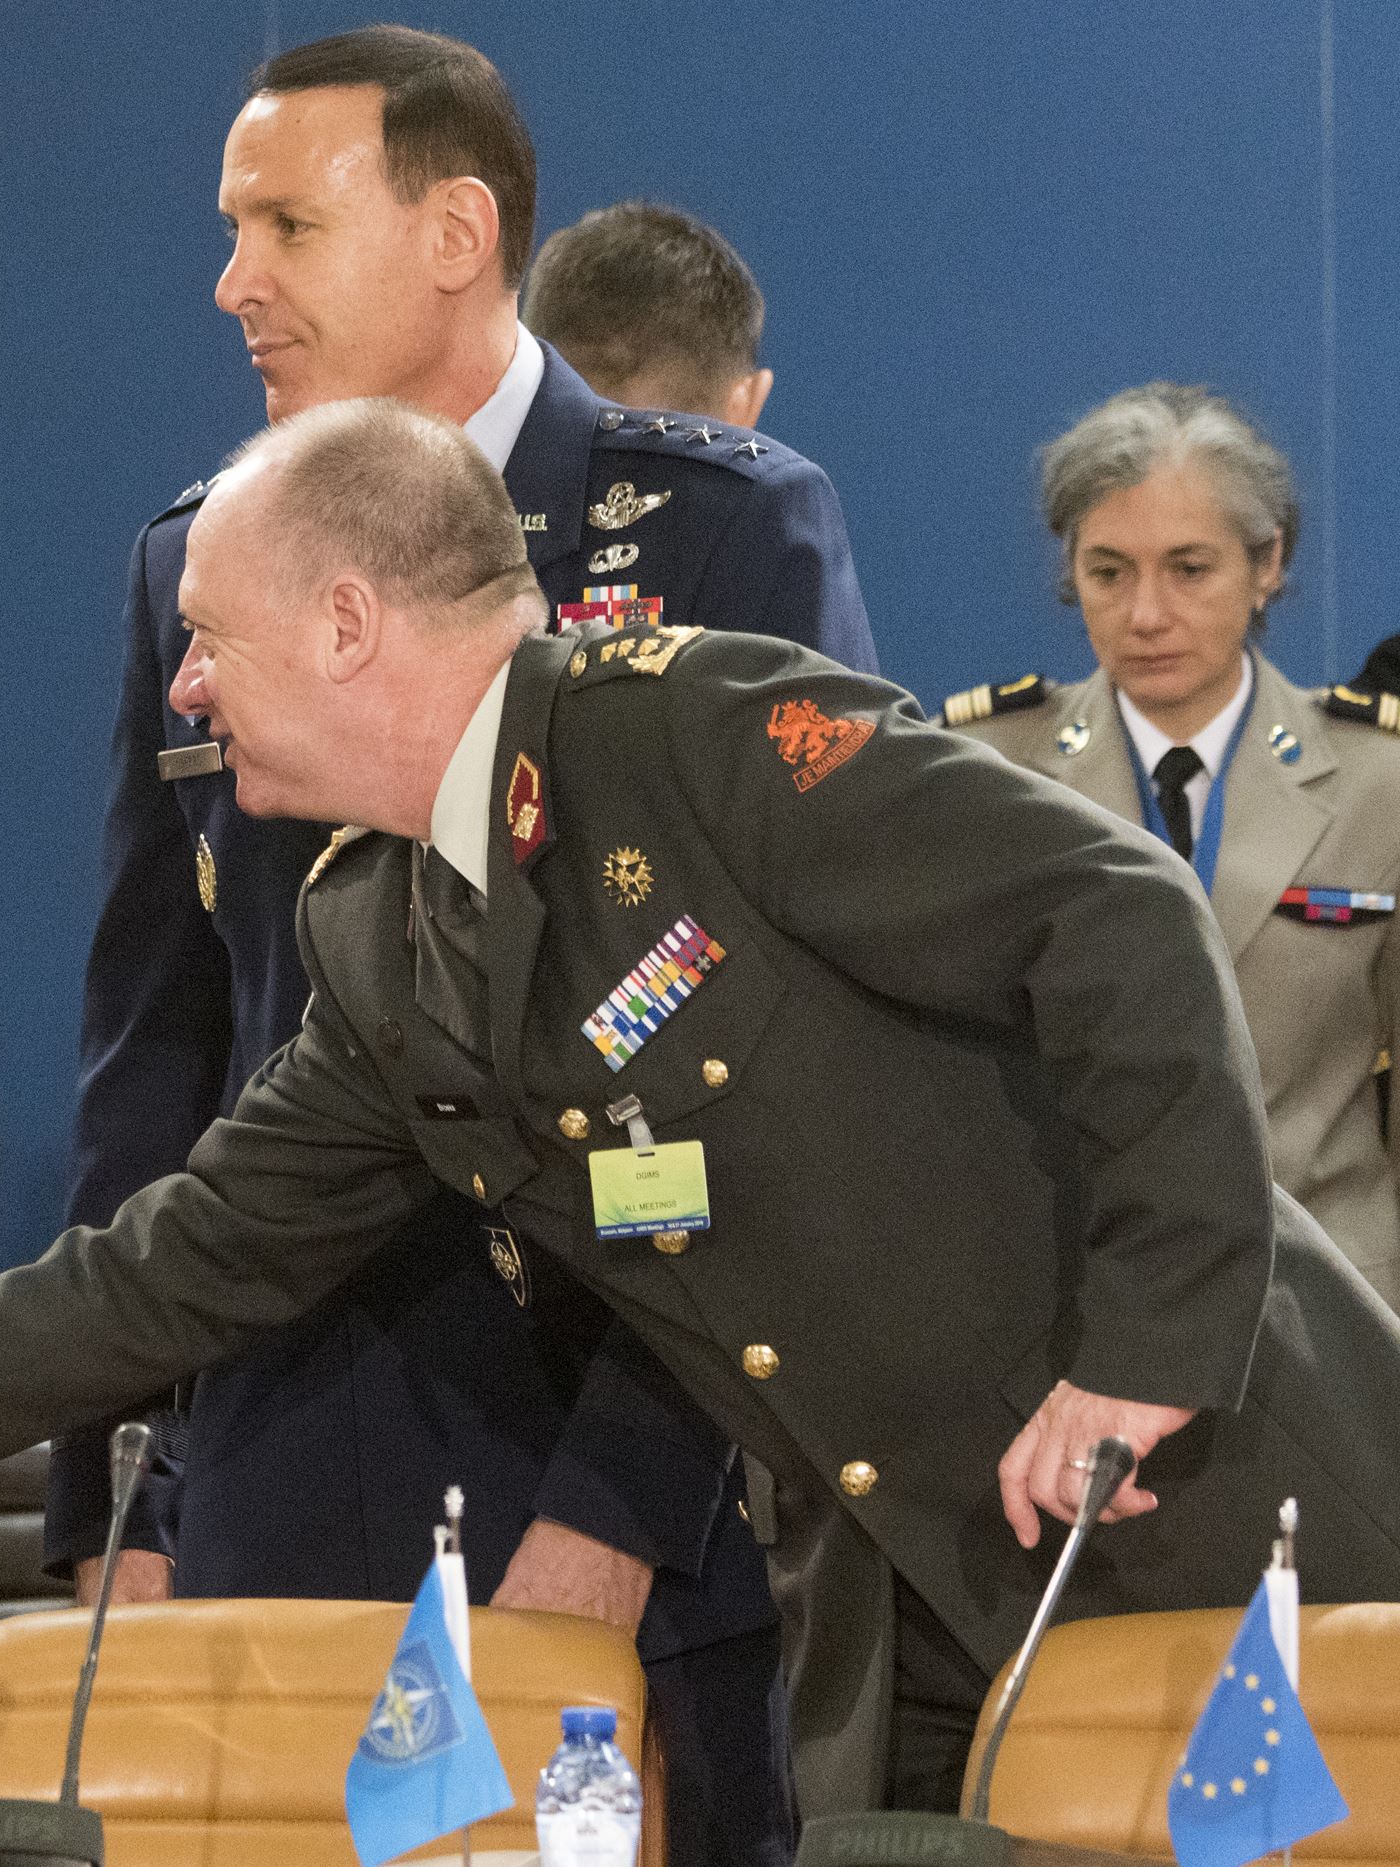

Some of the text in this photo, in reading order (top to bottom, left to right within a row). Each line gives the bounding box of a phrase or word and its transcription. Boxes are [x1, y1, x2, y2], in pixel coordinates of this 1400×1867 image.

[801, 769, 817, 786] JE
[624, 1200, 678, 1213] ALL MEETINGS
[830, 1828, 965, 1858] PHILIPS
